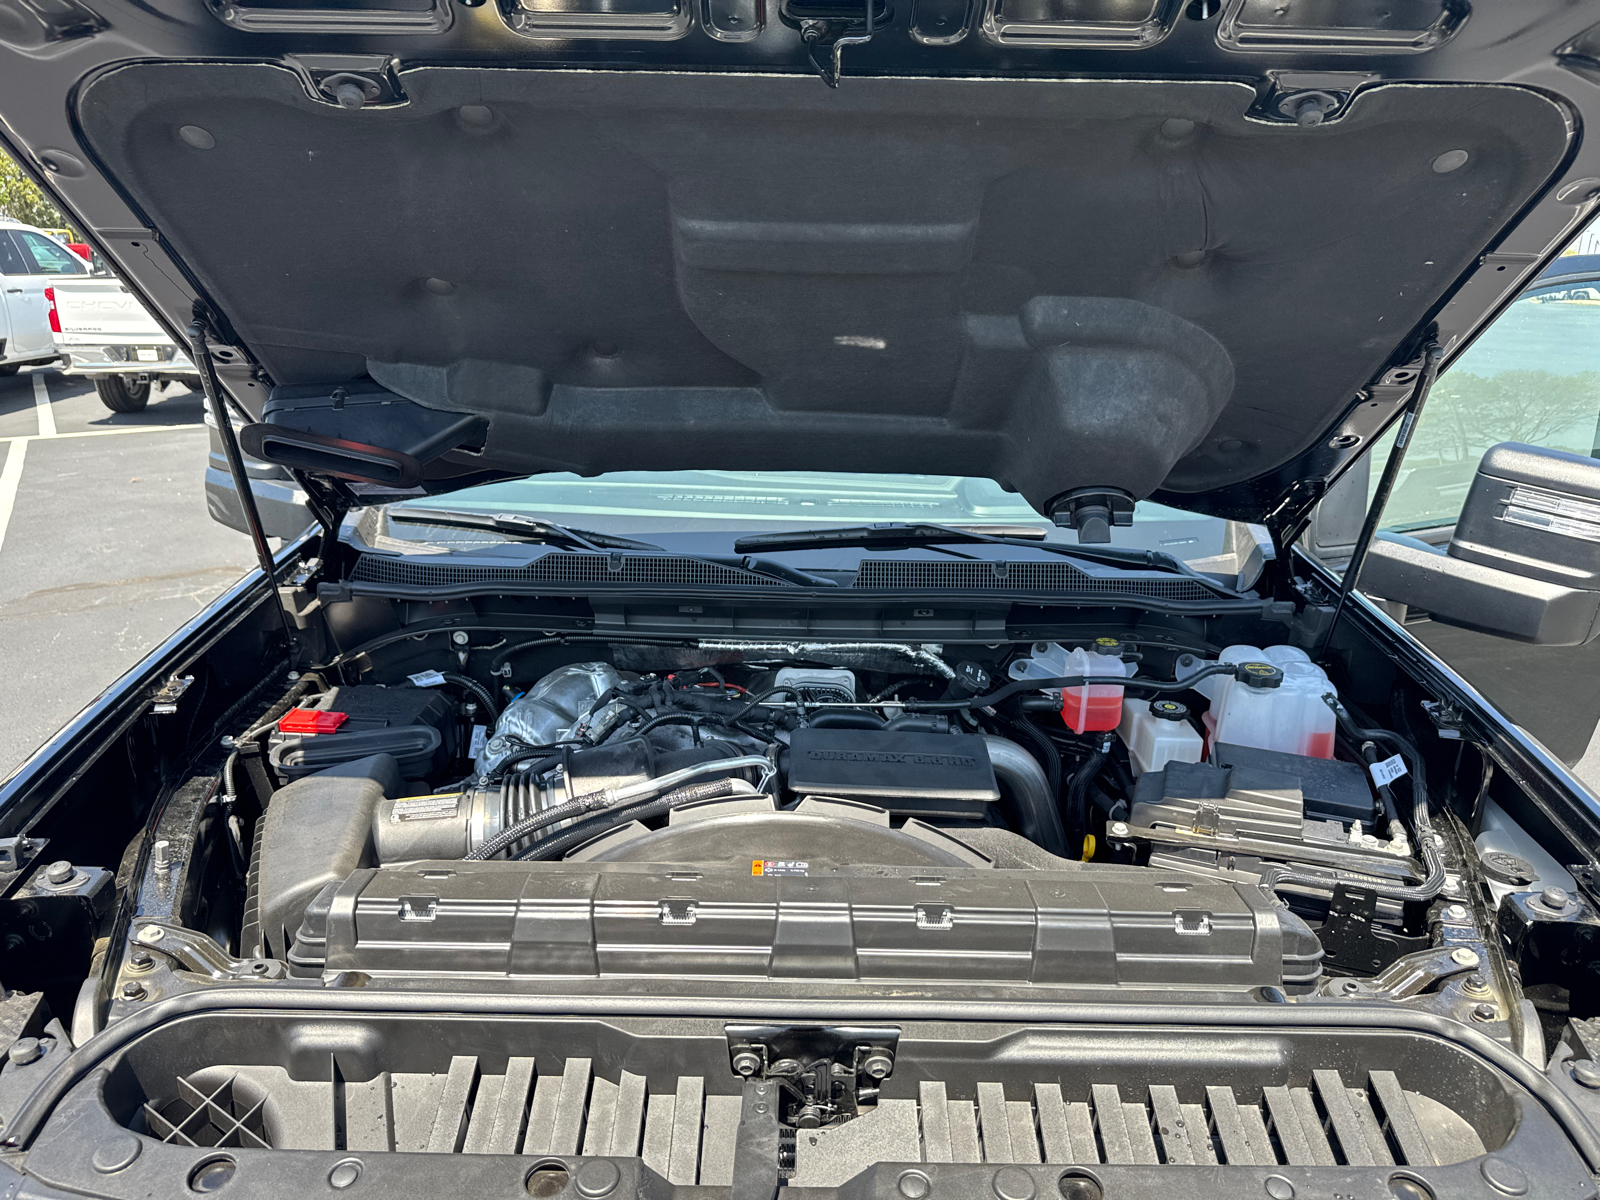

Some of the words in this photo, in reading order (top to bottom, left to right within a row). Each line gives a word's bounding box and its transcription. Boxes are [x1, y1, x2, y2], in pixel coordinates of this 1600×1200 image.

[807, 750, 906, 764] DURAMAX
[912, 753, 944, 765] 6.6
[948, 754, 976, 767] HD
